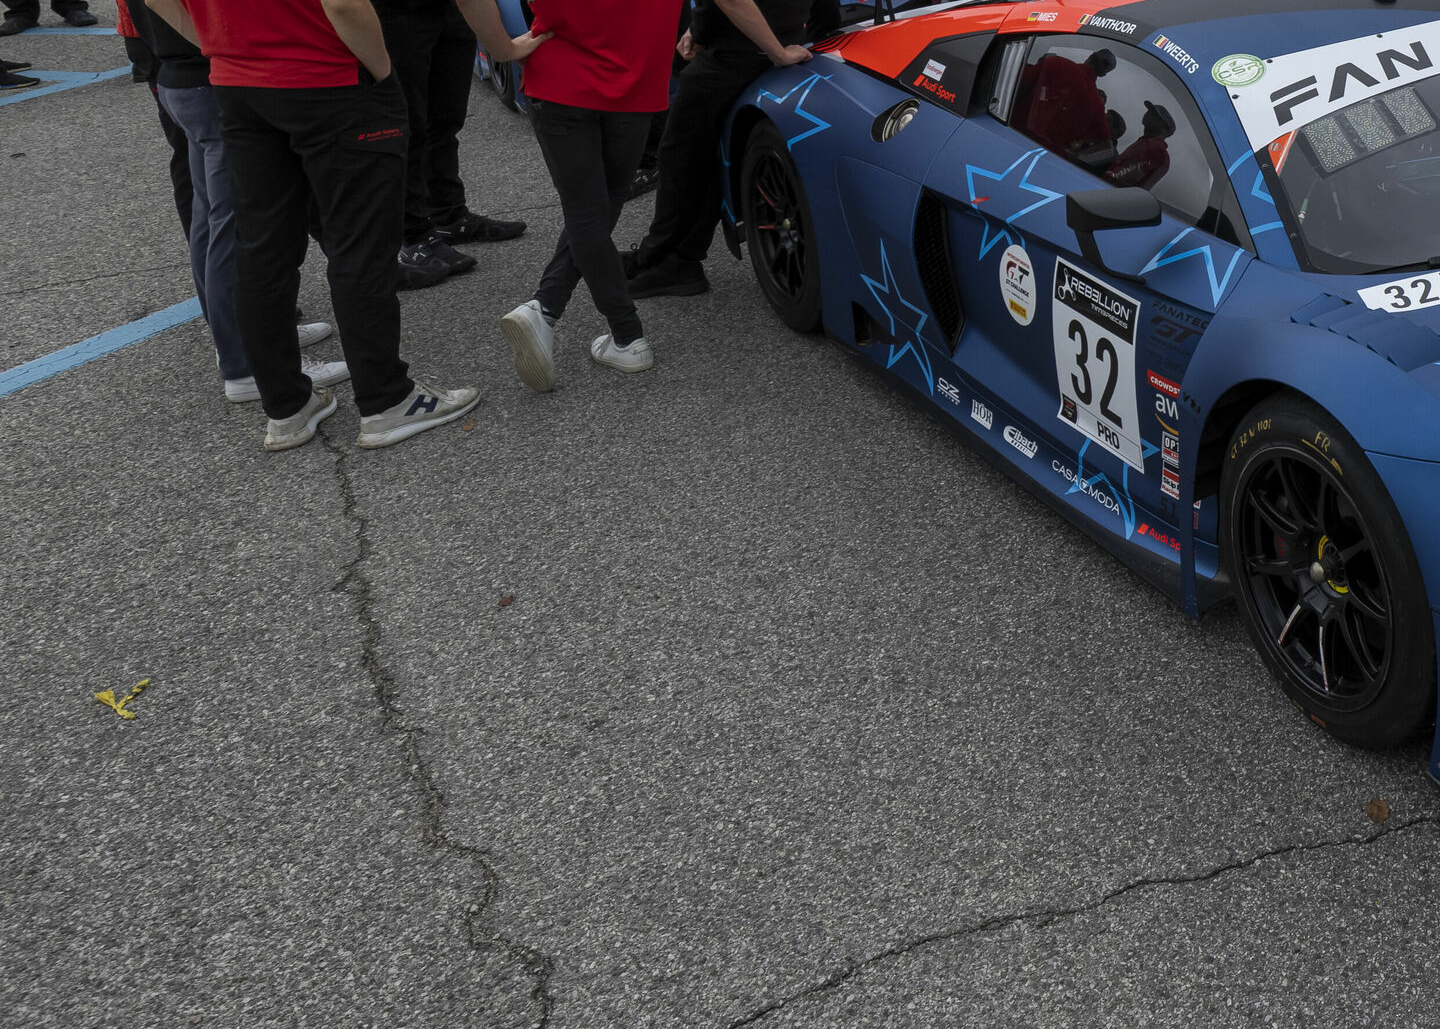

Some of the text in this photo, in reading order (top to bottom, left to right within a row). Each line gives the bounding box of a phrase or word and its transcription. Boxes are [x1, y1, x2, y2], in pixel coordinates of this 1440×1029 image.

[1037, 12, 1058, 22] MIES
[1089, 15, 1137, 34] VANTHOOR
[1163, 39, 1199, 74] WEERTS
[1218, 60, 1260, 80] CSR
[923, 77, 956, 103] Audi Sport
[1070, 276, 1130, 321] REBELLION
[1384, 277, 1440, 310] 32
[938, 376, 960, 399] OZ
[1068, 319, 1123, 429] 32
[1150, 376, 1180, 395] CROWDS
[1155, 393, 1179, 421] aw
[1003, 425, 1039, 454] Eibach
[1096, 420, 1120, 450] PRO
[1314, 430, 1331, 452] FR
[1052, 459, 1121, 516] CASA MODA
[1148, 528, 1169, 546] Audi
